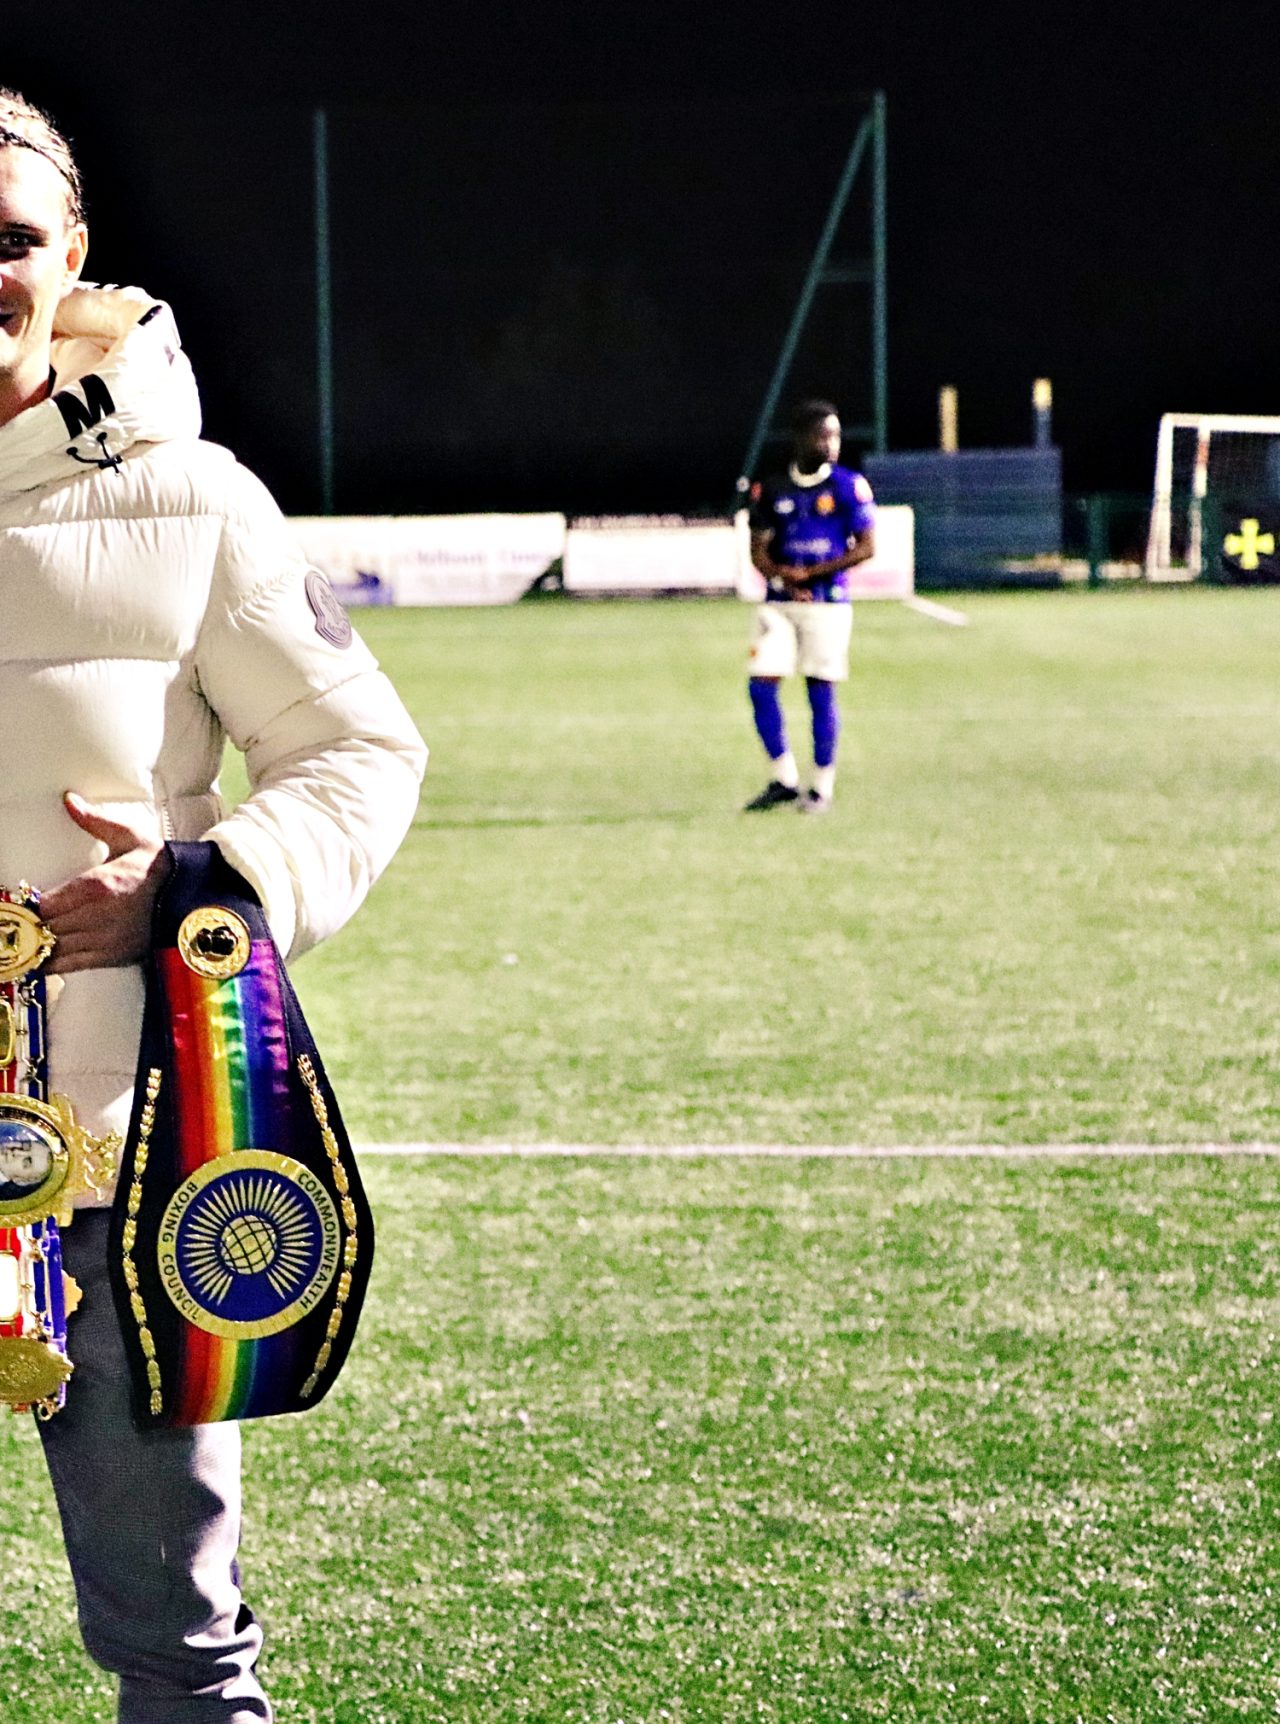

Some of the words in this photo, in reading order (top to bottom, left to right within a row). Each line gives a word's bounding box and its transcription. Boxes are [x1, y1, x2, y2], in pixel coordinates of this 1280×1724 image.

[162, 1181, 199, 1244] BOXING
[297, 1172, 337, 1310] COMMONWEALTH
[161, 1253, 200, 1321] COUNCIL
